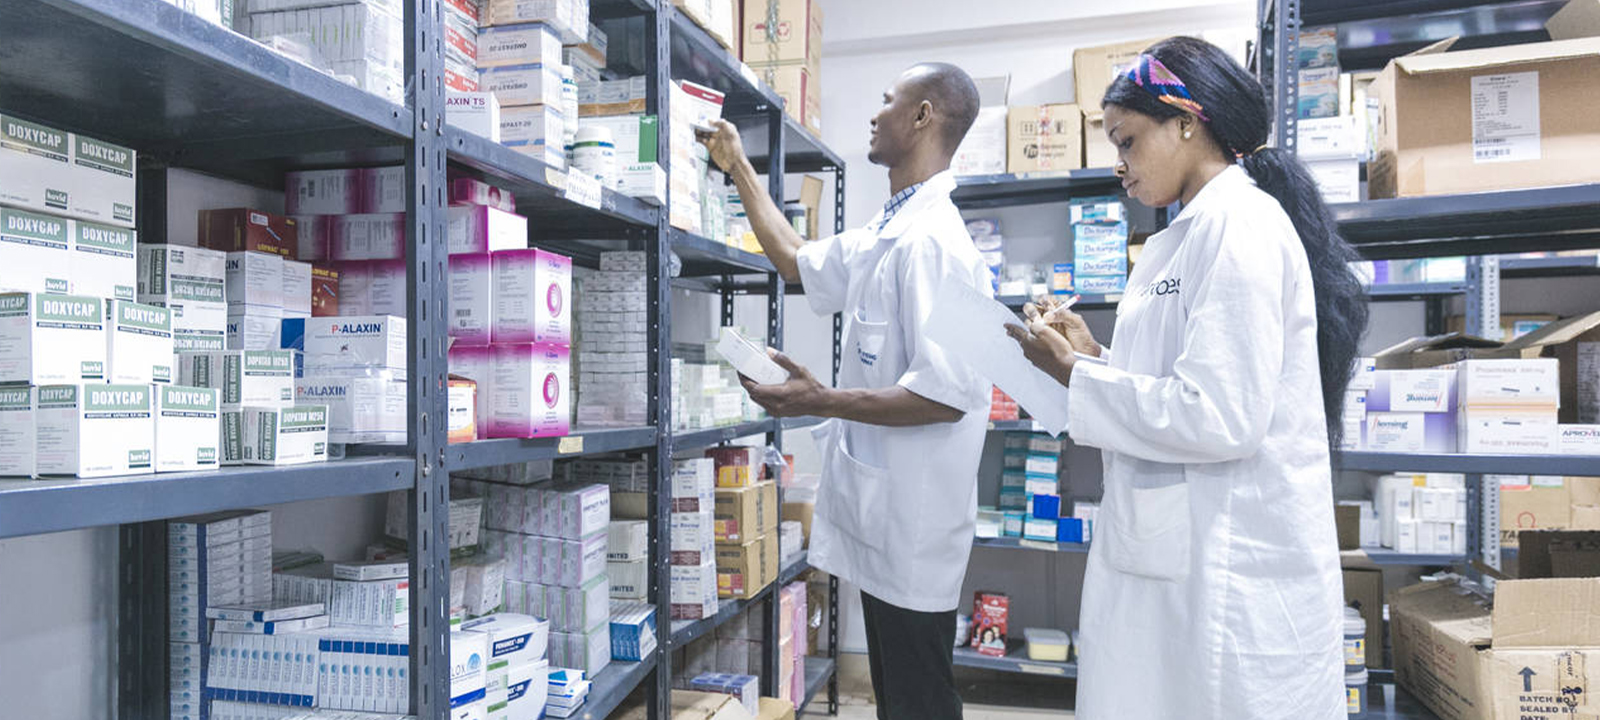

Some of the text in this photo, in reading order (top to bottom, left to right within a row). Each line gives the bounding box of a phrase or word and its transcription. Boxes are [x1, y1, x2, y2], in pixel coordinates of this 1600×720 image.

[447, 97, 486, 106] AXIN TS
[8, 122, 62, 149] DOXYCAP
[81, 141, 127, 165] DOXYCAP
[8, 215, 61, 237] DOXYCAP
[82, 226, 128, 244] DOXYCAP
[0, 295, 24, 309] XYCAP
[43, 300, 95, 317] DOXYCAP
[123, 306, 165, 324] DOXYCAP
[331, 323, 381, 334] P-ALAXIN
[0, 390, 27, 405] OXYCAP
[40, 388, 73, 401] DOXYCAP
[91, 390, 144, 406] DOXYCAP
[168, 390, 211, 406] DOXYCAP
[297, 386, 346, 396] P-ALAXIN
[1519, 695, 1553, 703] BATCH
